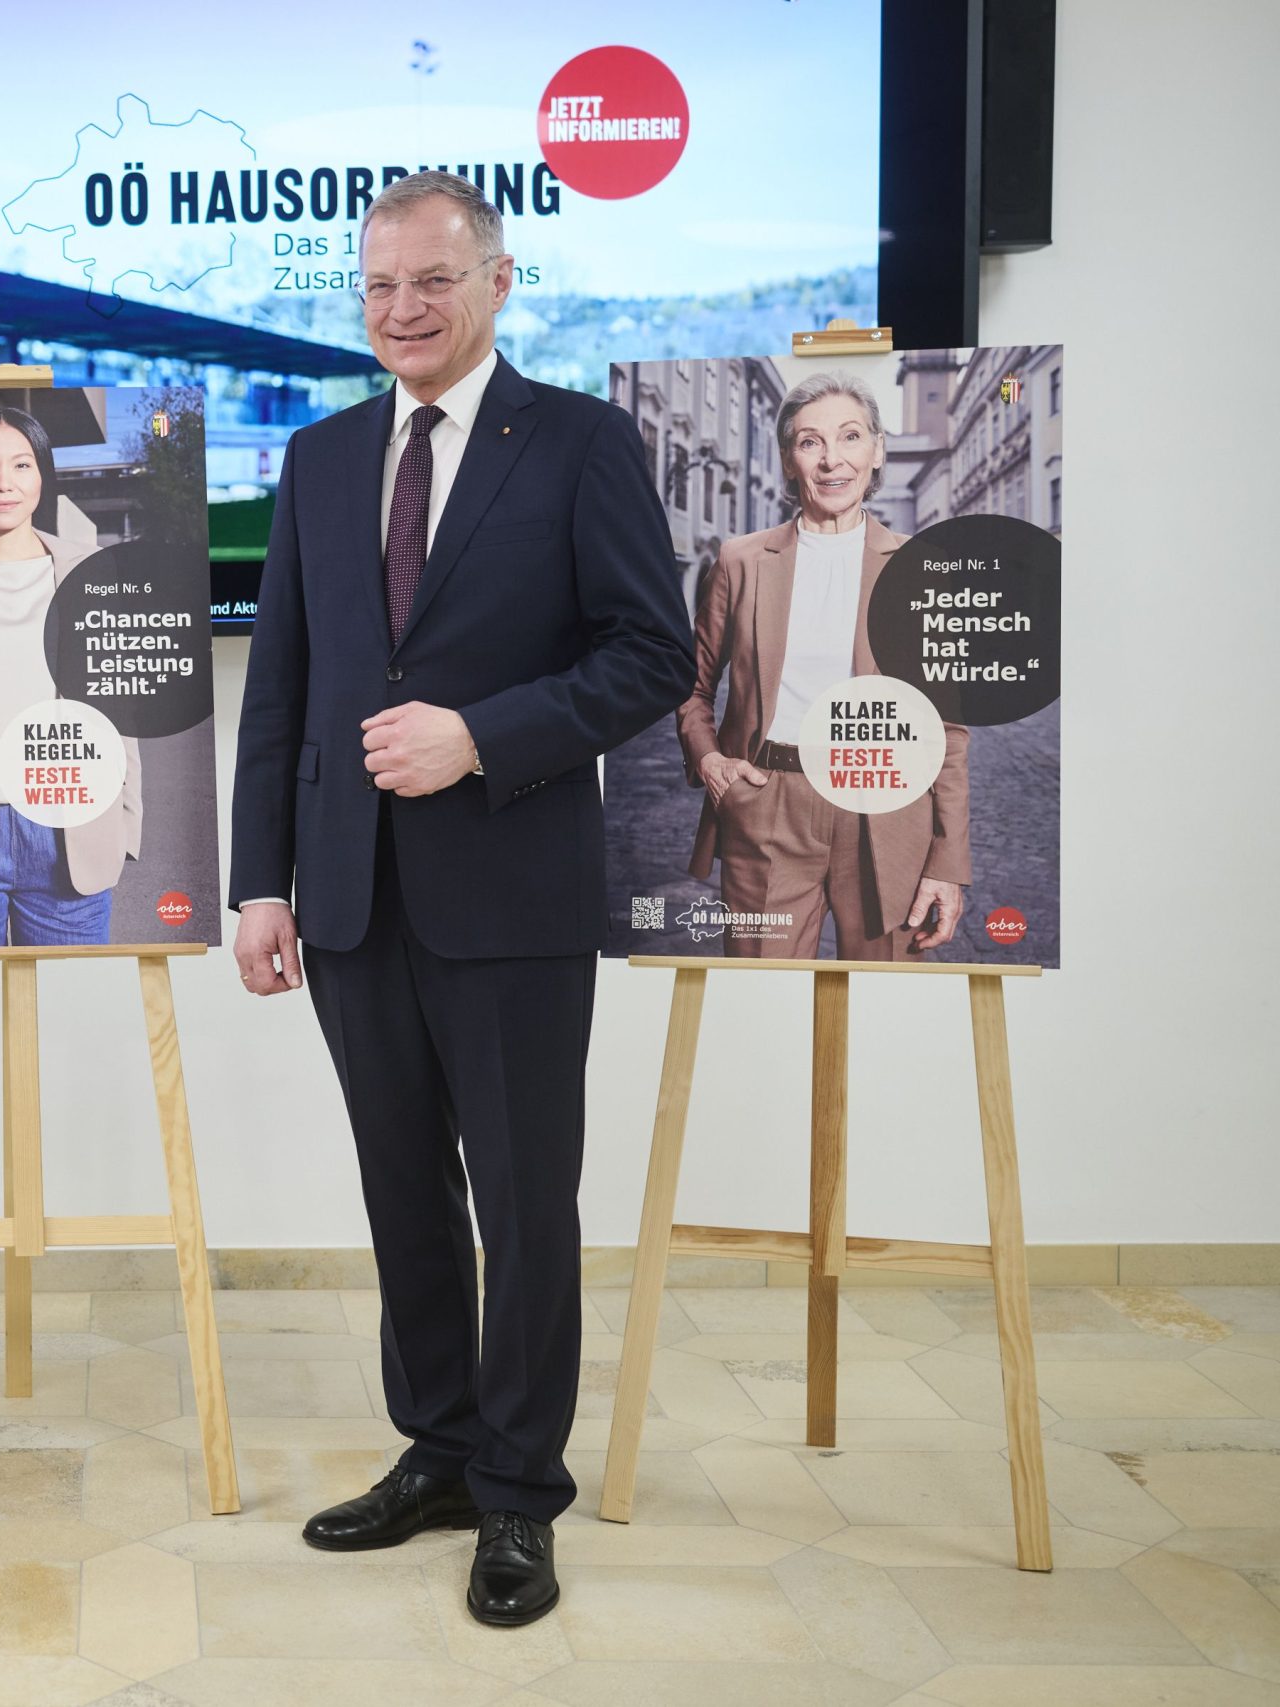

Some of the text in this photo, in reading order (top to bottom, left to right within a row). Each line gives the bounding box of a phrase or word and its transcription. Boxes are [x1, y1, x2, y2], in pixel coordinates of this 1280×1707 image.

[548, 96, 604, 119] JETZT
[548, 117, 681, 143] INFORMIEREN!
[86, 162, 560, 227] OÖ HAUSORNG
[274, 233, 328, 256] Das
[923, 559, 1000, 573] Regel Nr. 1
[84, 583, 152, 596] Regel Nr. 6
[910, 588, 1002, 611] „Jeder
[75, 609, 191, 631] „Chancen
[923, 611, 1031, 632] Mensch
[86, 632, 179, 651] nützen.
[922, 637, 969, 657] hat
[87, 655, 193, 676] Leistung
[922, 658, 1039, 682] Würde.“
[86, 674, 167, 696] zählt.“
[830, 701, 897, 720] KLARE
[24, 723, 82, 741] KLARE
[830, 723, 917, 741] REGELN.
[24, 743, 101, 761] REGELN.
[830, 749, 893, 767] FESTE
[24, 767, 81, 785] FESTE
[830, 770, 907, 789] WERTE.
[24, 787, 94, 805] WERTE.
[692, 910, 793, 926] OÖ HAUSORDNUNG
